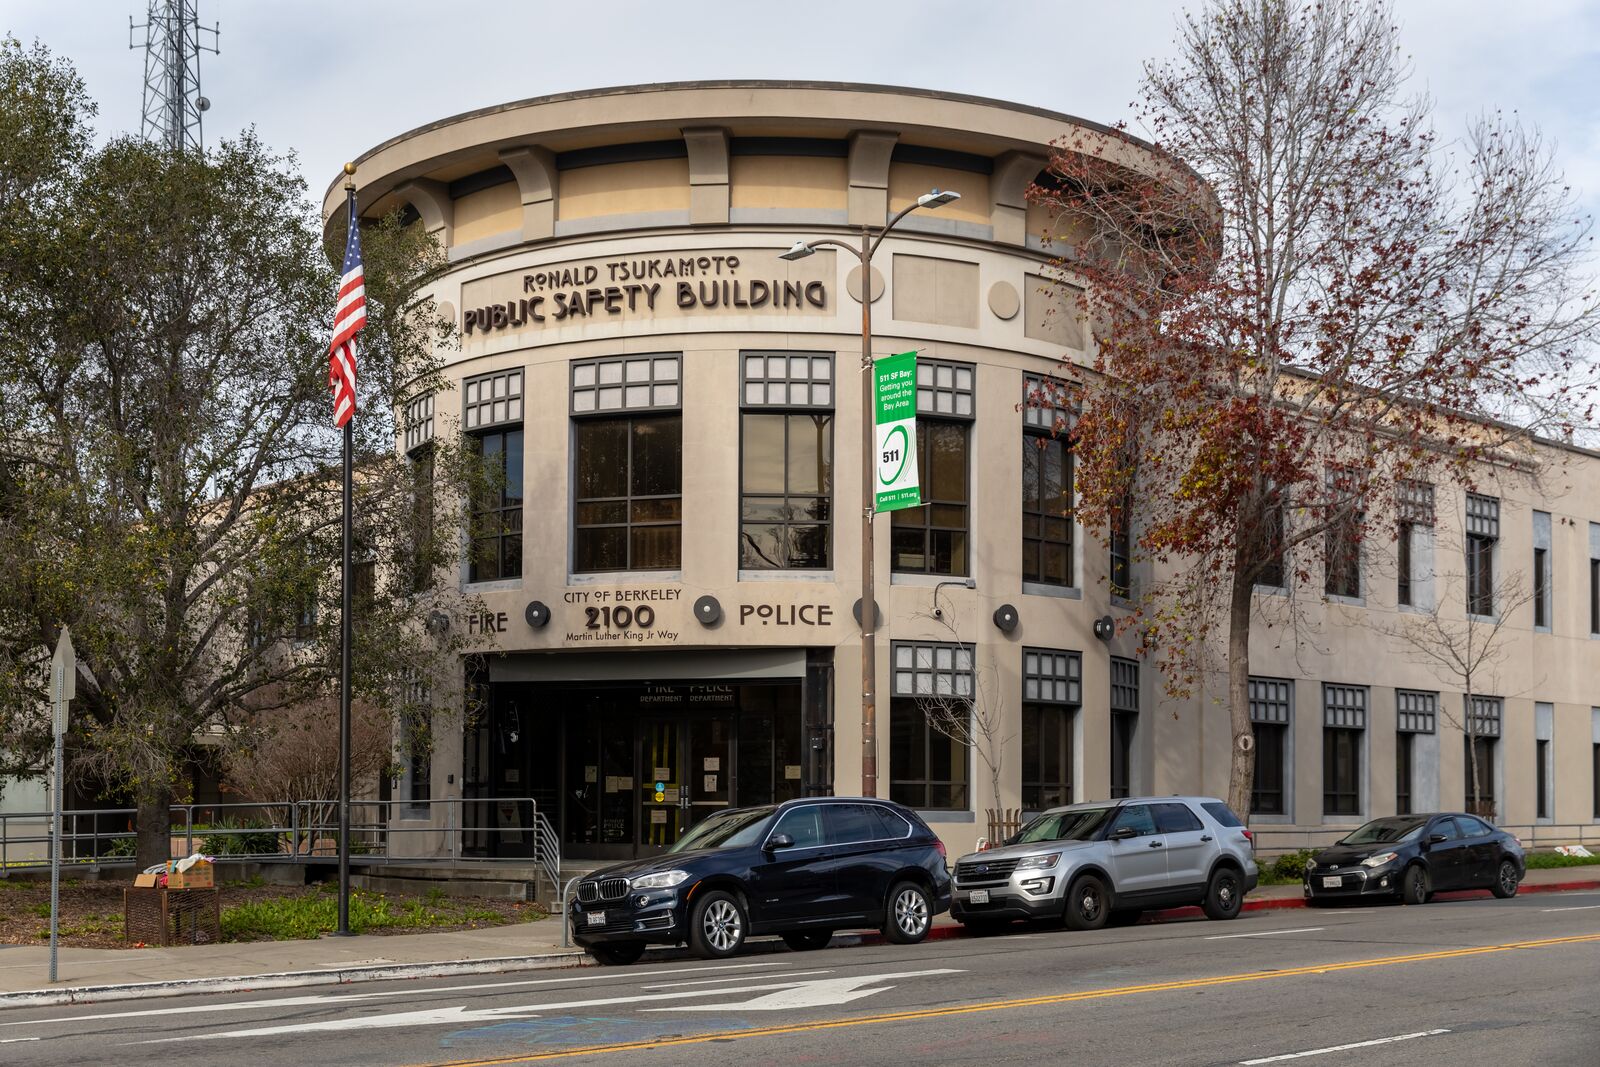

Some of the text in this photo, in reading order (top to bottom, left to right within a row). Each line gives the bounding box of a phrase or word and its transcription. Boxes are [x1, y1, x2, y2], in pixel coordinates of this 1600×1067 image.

[523, 255, 740, 293] RONALD TSUKAMOTO
[463, 279, 826, 335] PUBLIC SAFETY BUILDING
[879, 374, 889, 383] 511
[890, 371, 898, 380] SF
[879, 380, 913, 392] Getting you
[881, 389, 912, 401] around the
[883, 400, 909, 411] Bay Area
[882, 449, 899, 464] 511
[563, 589, 682, 603] CITY OF BERKELEY
[584, 604, 655, 629] 2100
[739, 603, 834, 627] POLICE
[469, 612, 508, 635] FIRE
[566, 630, 679, 642] Martin Luther King Jr Way
[640, 695, 683, 703] DEPARTMENT
[689, 694, 734, 702] DEPARTMENT
